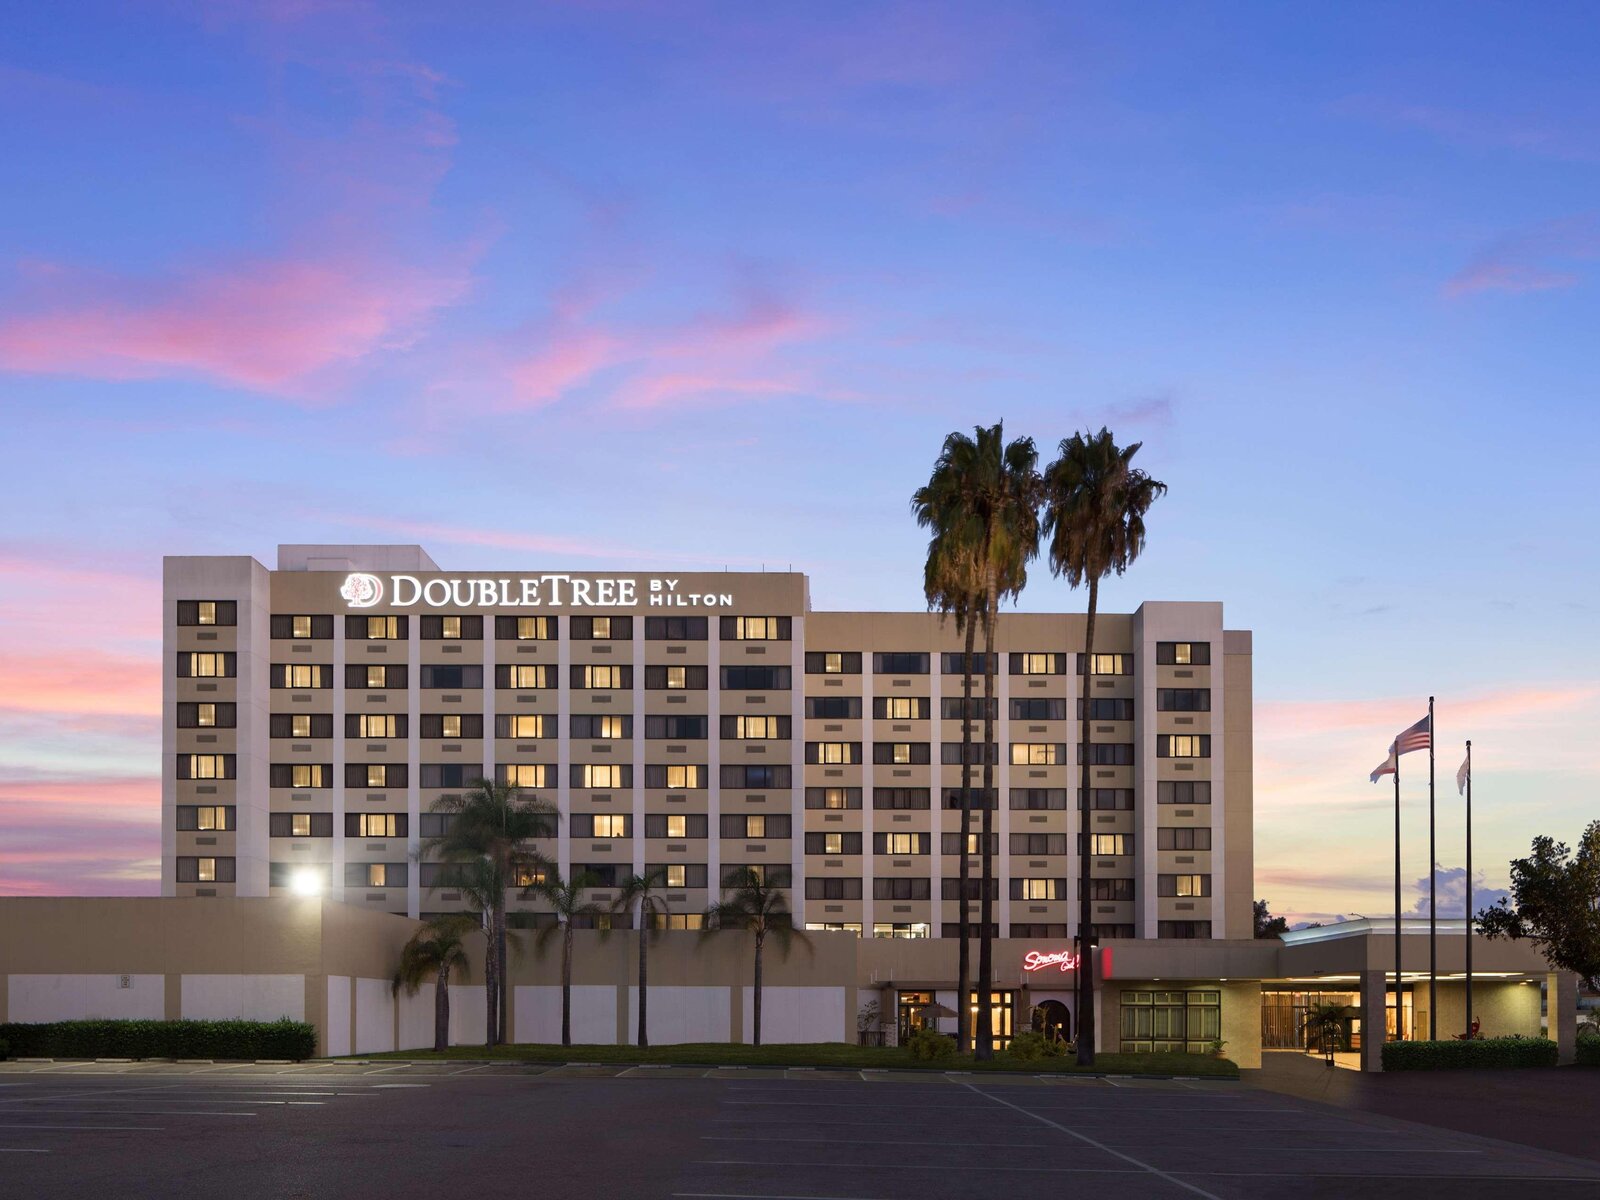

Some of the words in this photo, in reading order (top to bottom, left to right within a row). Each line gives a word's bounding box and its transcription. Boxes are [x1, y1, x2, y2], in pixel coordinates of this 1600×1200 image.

[390, 574, 638, 606] DOUBLETREE
[650, 579, 679, 592] BY
[650, 594, 733, 606] HILTON
[1024, 951, 1071, 970] Sonoma
